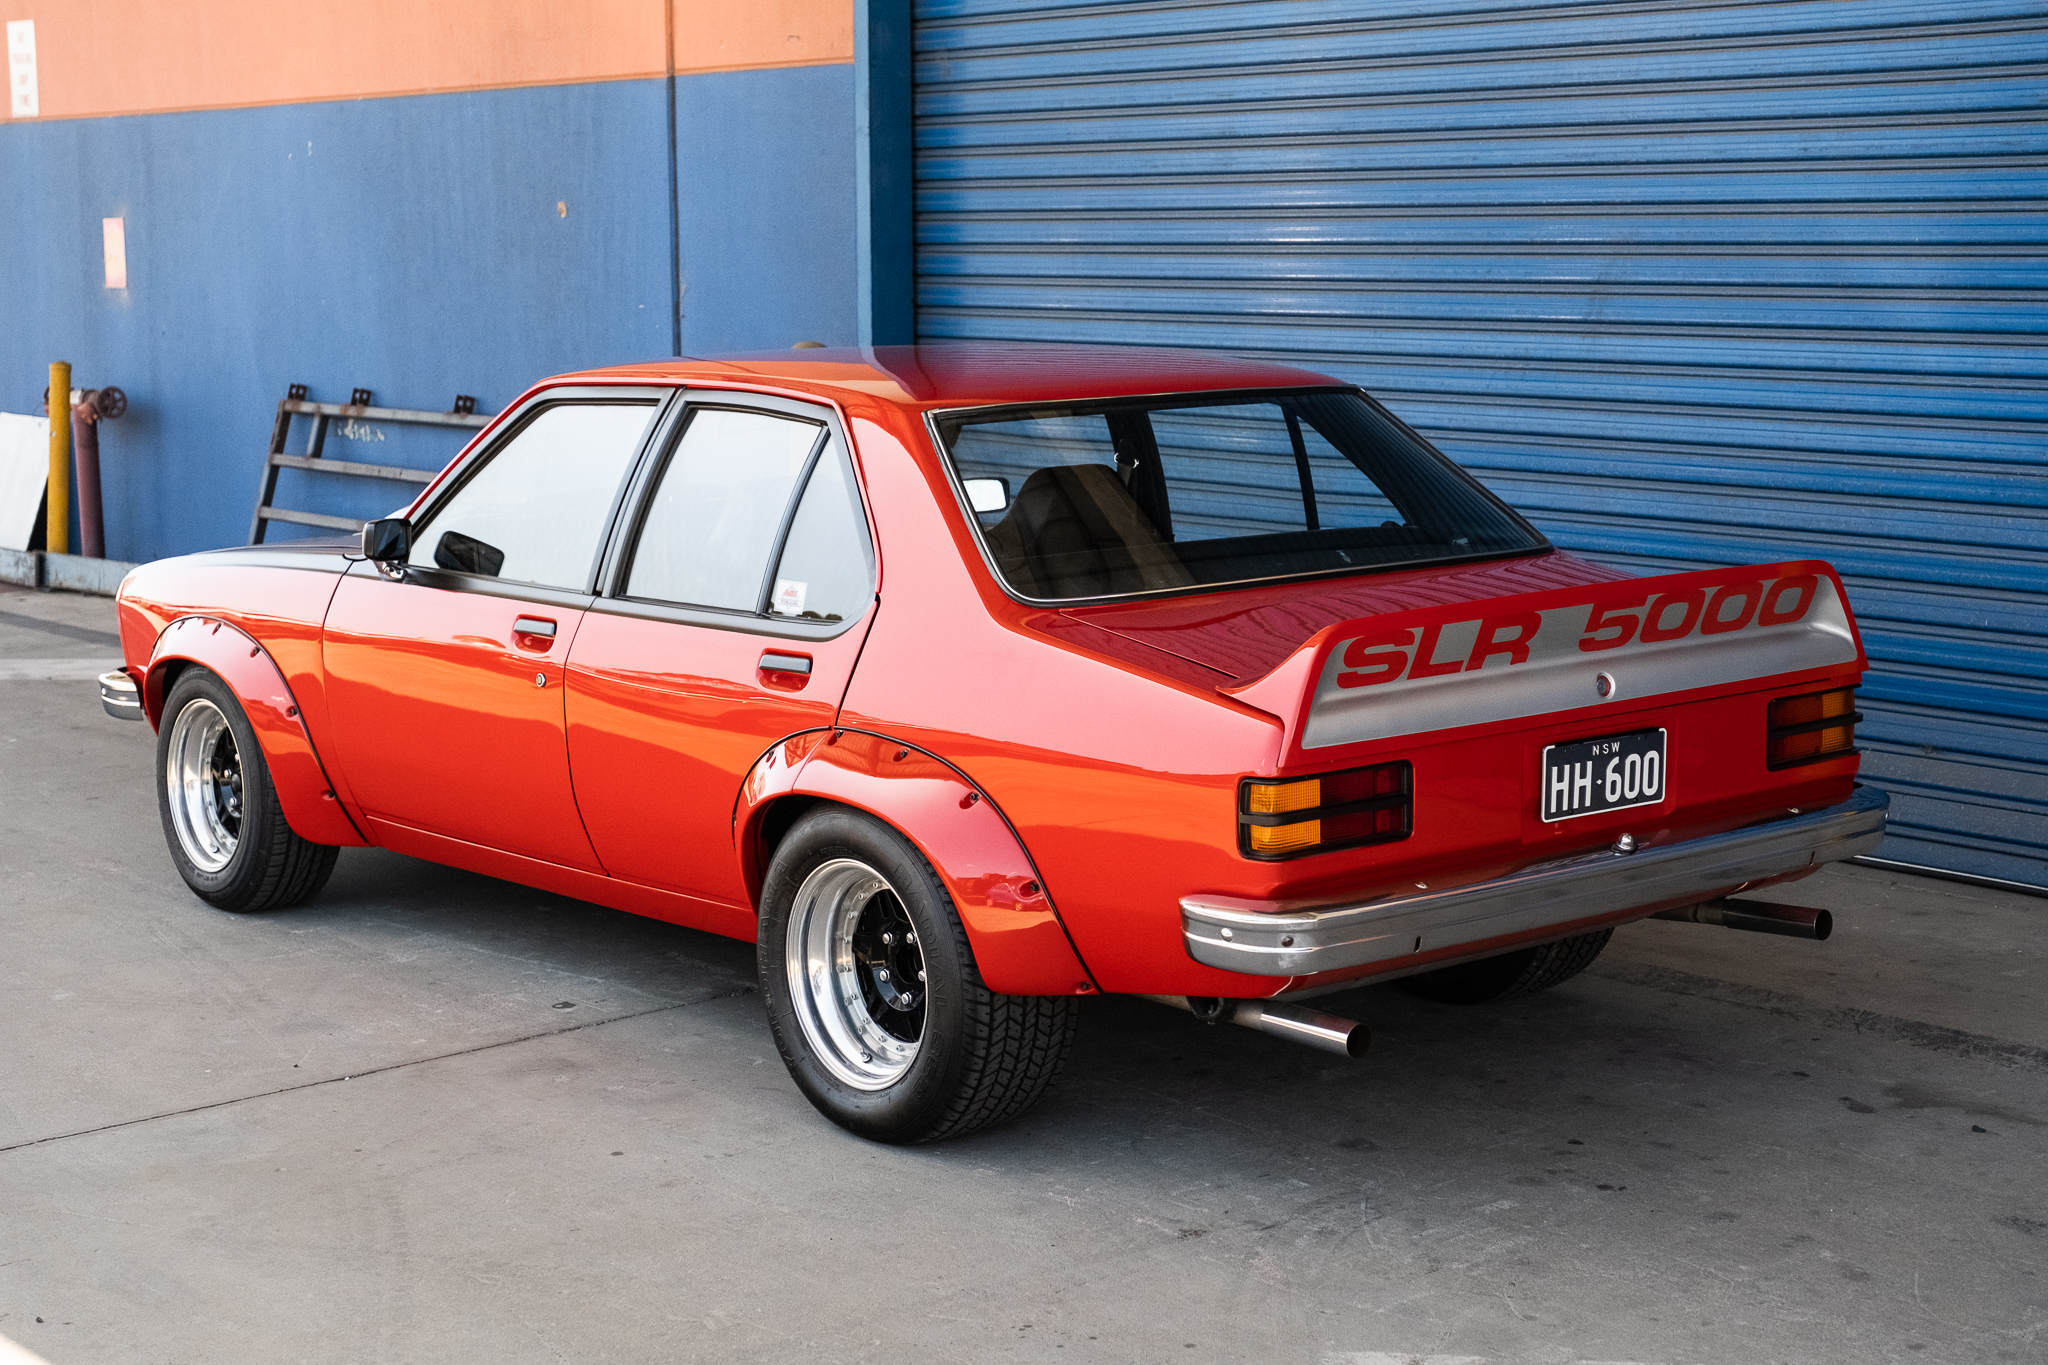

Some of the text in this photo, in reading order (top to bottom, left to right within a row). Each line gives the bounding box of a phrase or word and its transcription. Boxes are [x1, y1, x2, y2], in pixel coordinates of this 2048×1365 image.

[1337, 574, 1819, 689] SLR 5000
[1592, 742, 1621, 756] NSW
[895, 863, 948, 1017] RADIAL
